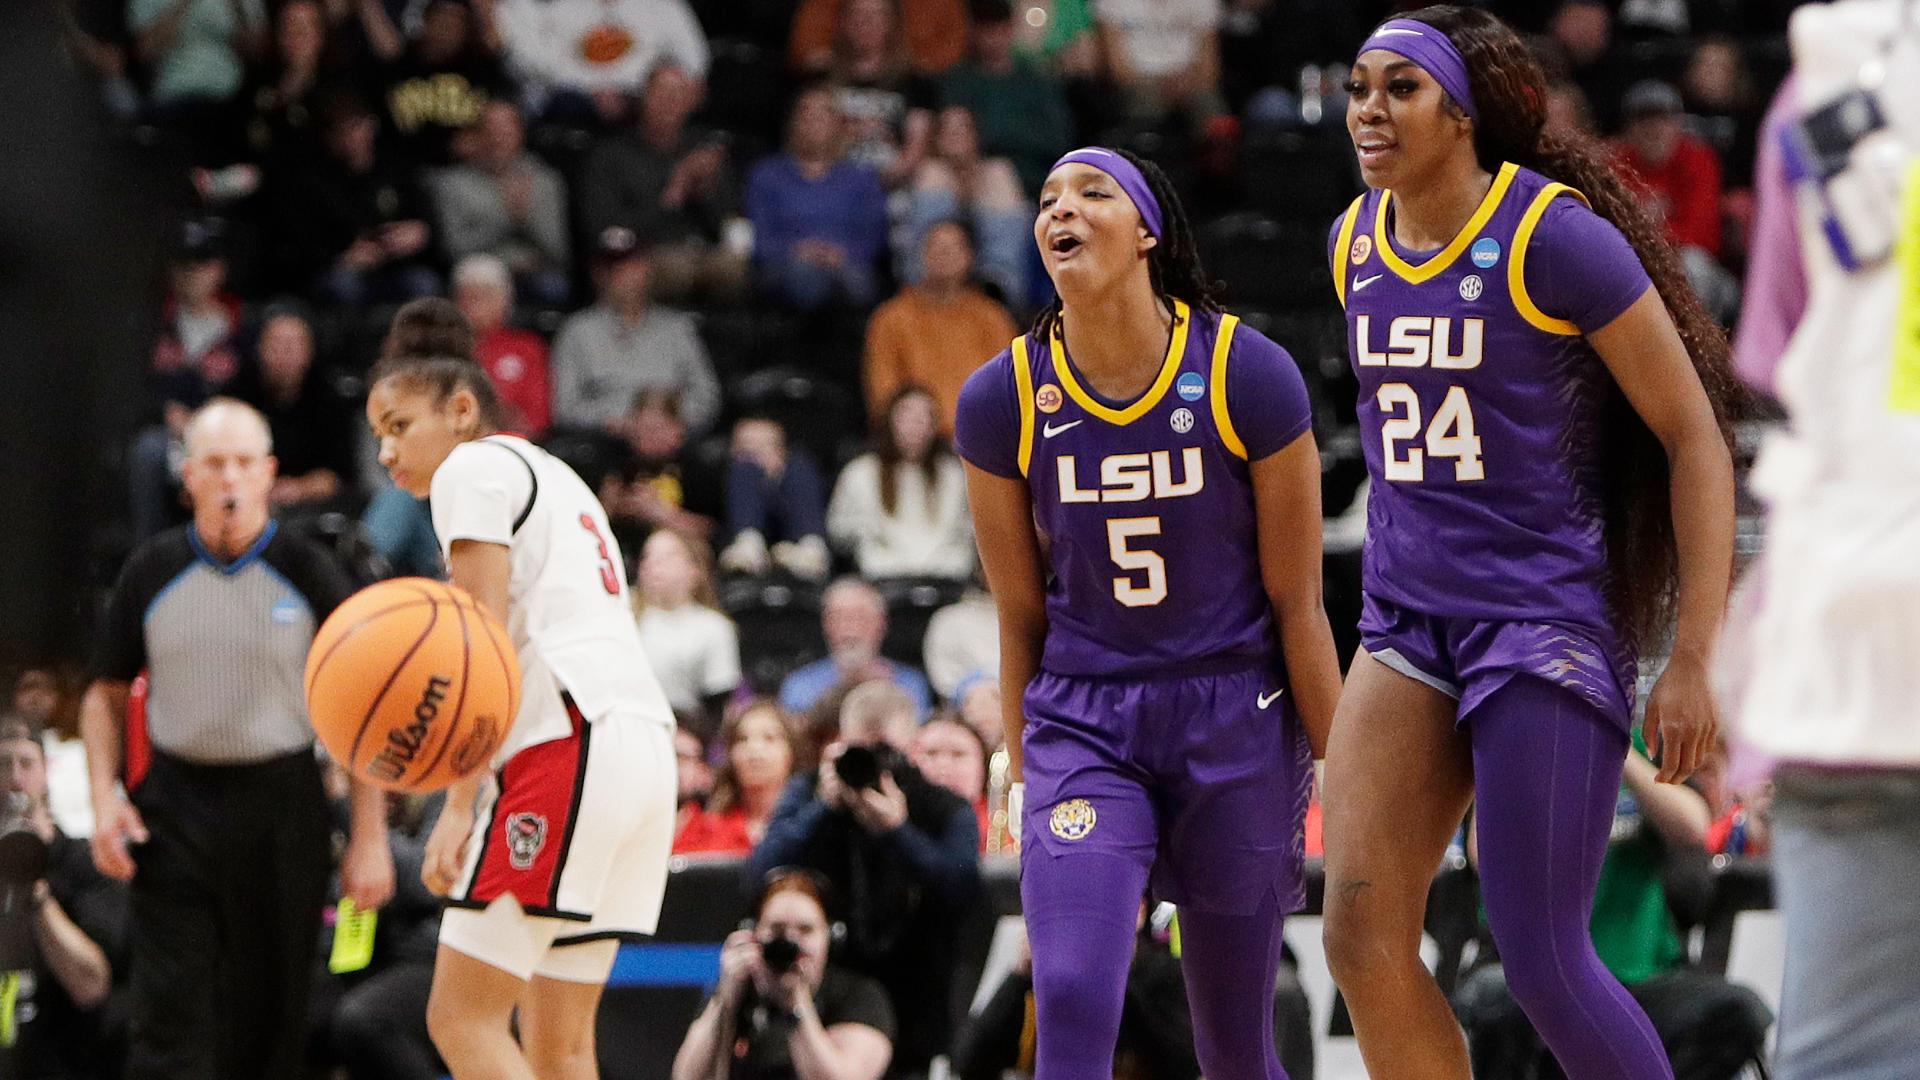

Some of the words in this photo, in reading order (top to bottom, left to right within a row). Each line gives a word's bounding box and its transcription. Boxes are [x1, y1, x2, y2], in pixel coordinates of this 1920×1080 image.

[1461, 277, 1481, 298] SEC
[1356, 315, 1484, 369] LSU
[1172, 409, 1193, 431] SEC
[1376, 382, 1485, 482] 24
[1056, 447, 1205, 503] LSU
[579, 513, 620, 595] 3
[1106, 516, 1168, 607] 5
[368, 674, 451, 781] Wilson
